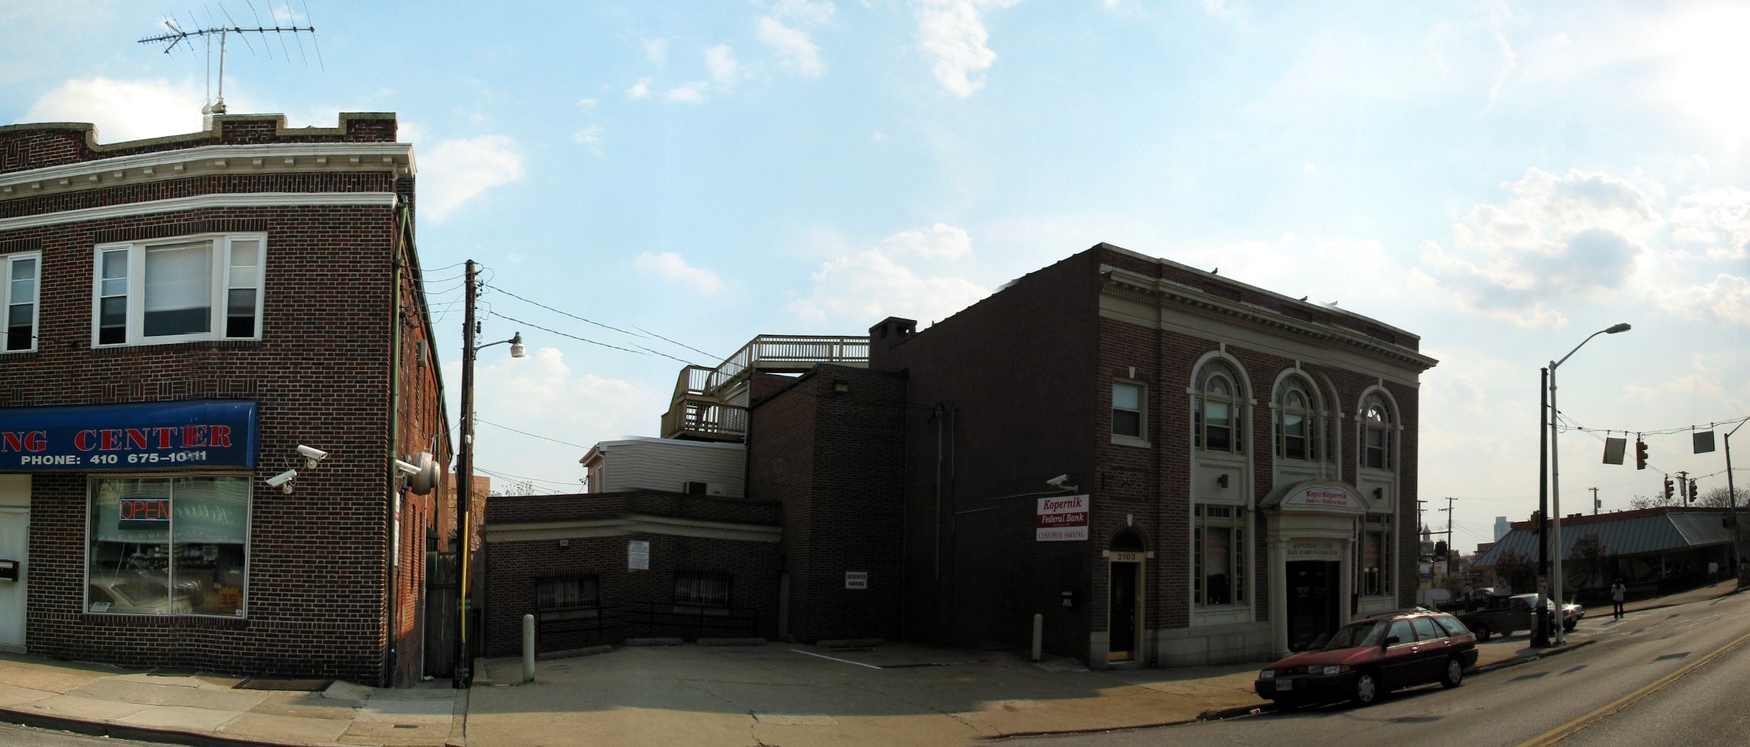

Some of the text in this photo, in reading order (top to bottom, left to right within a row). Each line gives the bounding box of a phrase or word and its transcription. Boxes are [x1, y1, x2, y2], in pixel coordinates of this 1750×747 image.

[74, 424, 233, 451] CENTER
[21, 455, 81, 465] PHONE:
[90, 454, 118, 464] 410
[121, 501, 170, 519] OPEN
[1043, 497, 1082, 512] Kopernik
[1041, 513, 1084, 523] Federal Bank
[1038, 531, 1063, 539] CUSTOMER
